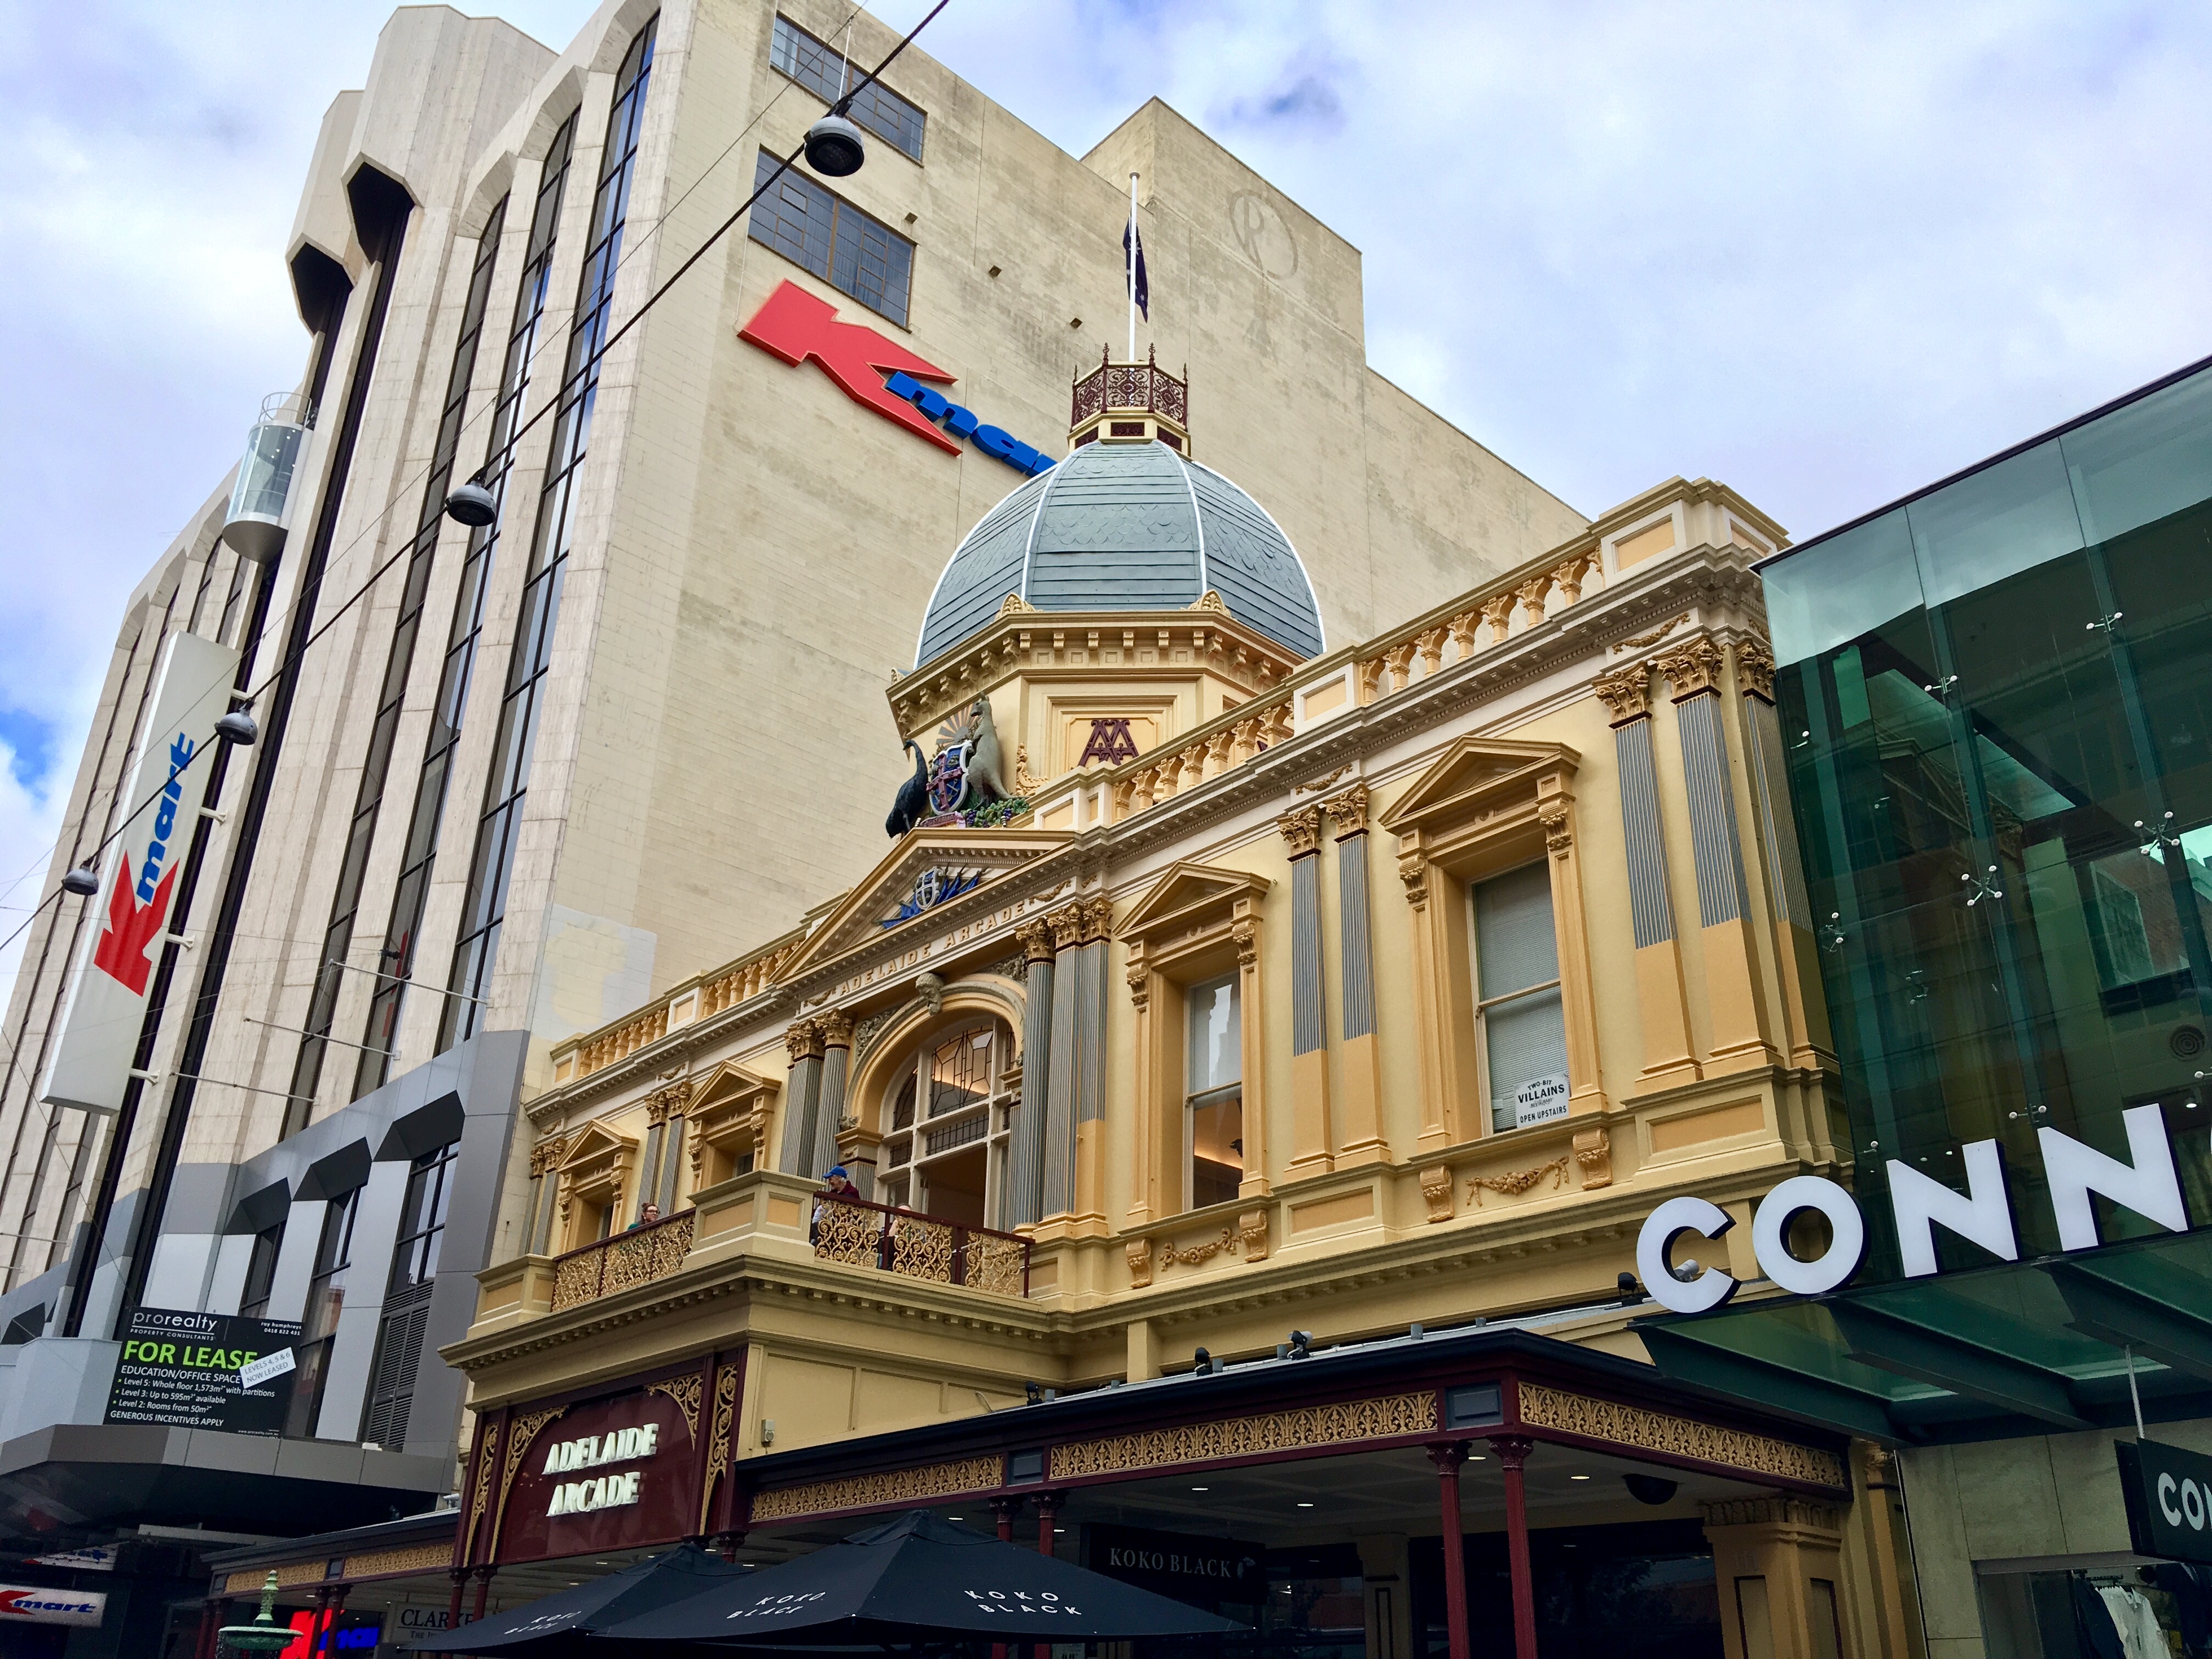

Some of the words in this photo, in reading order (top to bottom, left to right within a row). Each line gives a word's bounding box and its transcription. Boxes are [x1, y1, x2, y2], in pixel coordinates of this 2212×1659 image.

[93, 732, 195, 997] Kmart
[840, 944, 931, 996] ADELAIDE
[944, 901, 1025, 950] ARCADE
[1518, 1084, 1565, 1103] VILLAINS
[1527, 1080, 1552, 1091] TWO-BIT
[1520, 1113, 1536, 1123] OPEN
[1537, 1105, 1567, 1119] UPSTAIRS
[1636, 1103, 2192, 1313] CONN
[132, 1312, 217, 1331] prorealty
[167, 1332, 214, 1341] CONSULTANTS
[123, 1340, 176, 1364] FOR
[183, 1346, 258, 1370] LEASE
[121, 1365, 212, 1381] EDUCATION/OFFICE
[213, 1373, 241, 1384] SPACE
[244, 1362, 267, 1375] LEVELS
[247, 1373, 263, 1383] NOW
[264, 1362, 289, 1376] LEASED
[121, 1388, 140, 1396] Level
[149, 1391, 160, 1400] Up
[196, 1395, 226, 1404] available
[124, 1377, 143, 1386] Level
[153, 1380, 175, 1389] Whole
[176, 1381, 193, 1391] floor
[242, 1389, 275, 1397] partitions
[119, 1399, 138, 1407] Level
[146, 1401, 171, 1410] Rooms
[172, 1403, 189, 1412] from
[110, 1410, 154, 1421] GENEROUS
[154, 1414, 199, 1425] INCENTIVES
[200, 1418, 224, 1426] APPLY
[541, 1423, 659, 1475] ADELAIDE
[546, 1471, 641, 1516] ARCADE
[1109, 1548, 1164, 1570] KOKO
[1170, 1554, 1231, 1578] BLACK
[755, 1592, 826, 1606] KOKO
[964, 1590, 1059, 1601] KOKO
[726, 1606, 803, 1619] BLACK
[978, 1604, 1082, 1615] BLACK
